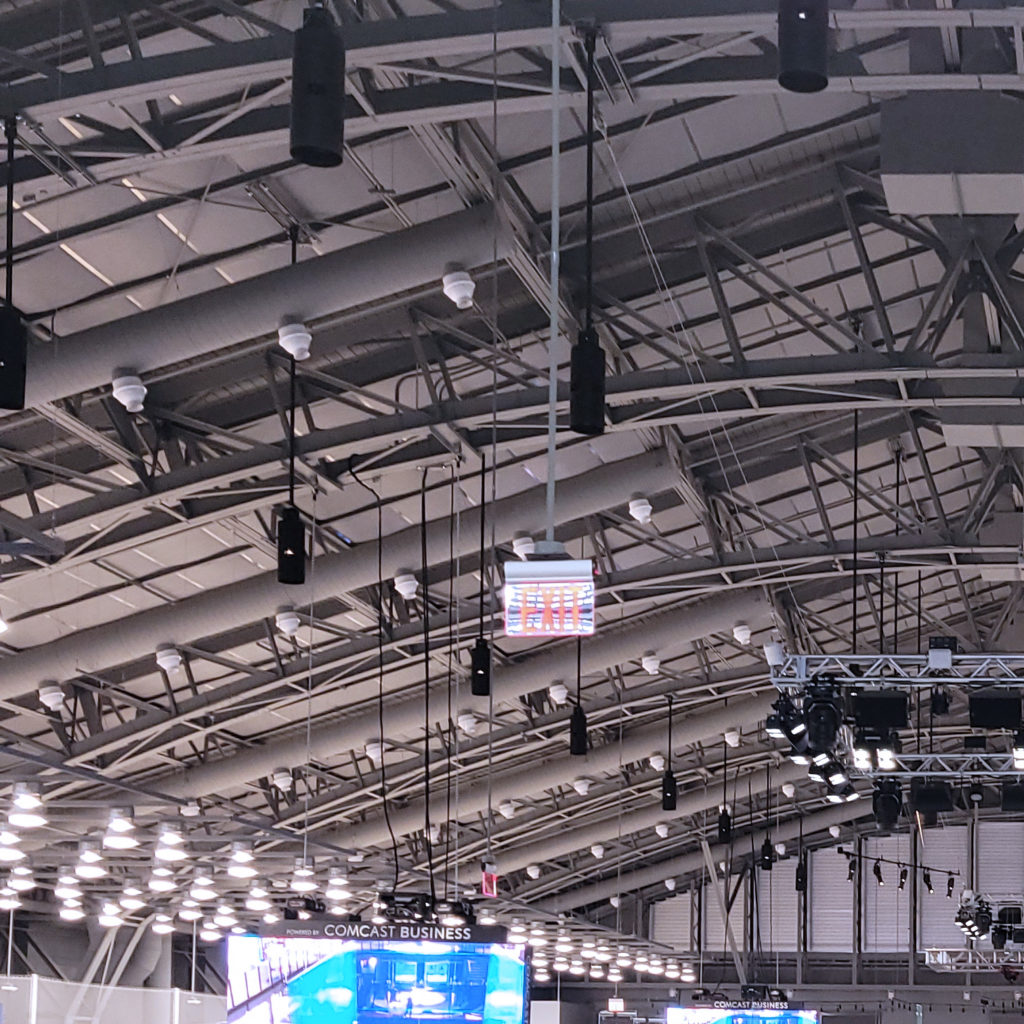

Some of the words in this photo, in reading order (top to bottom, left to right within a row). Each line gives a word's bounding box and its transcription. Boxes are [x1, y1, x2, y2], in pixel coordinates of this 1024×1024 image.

[522, 586, 583, 633] EXIT
[324, 924, 395, 938] COMCAST
[400, 925, 471, 940] BUSINESS
[713, 1001, 750, 1009] COMCAST
[751, 1001, 789, 1009] BUSINESS
